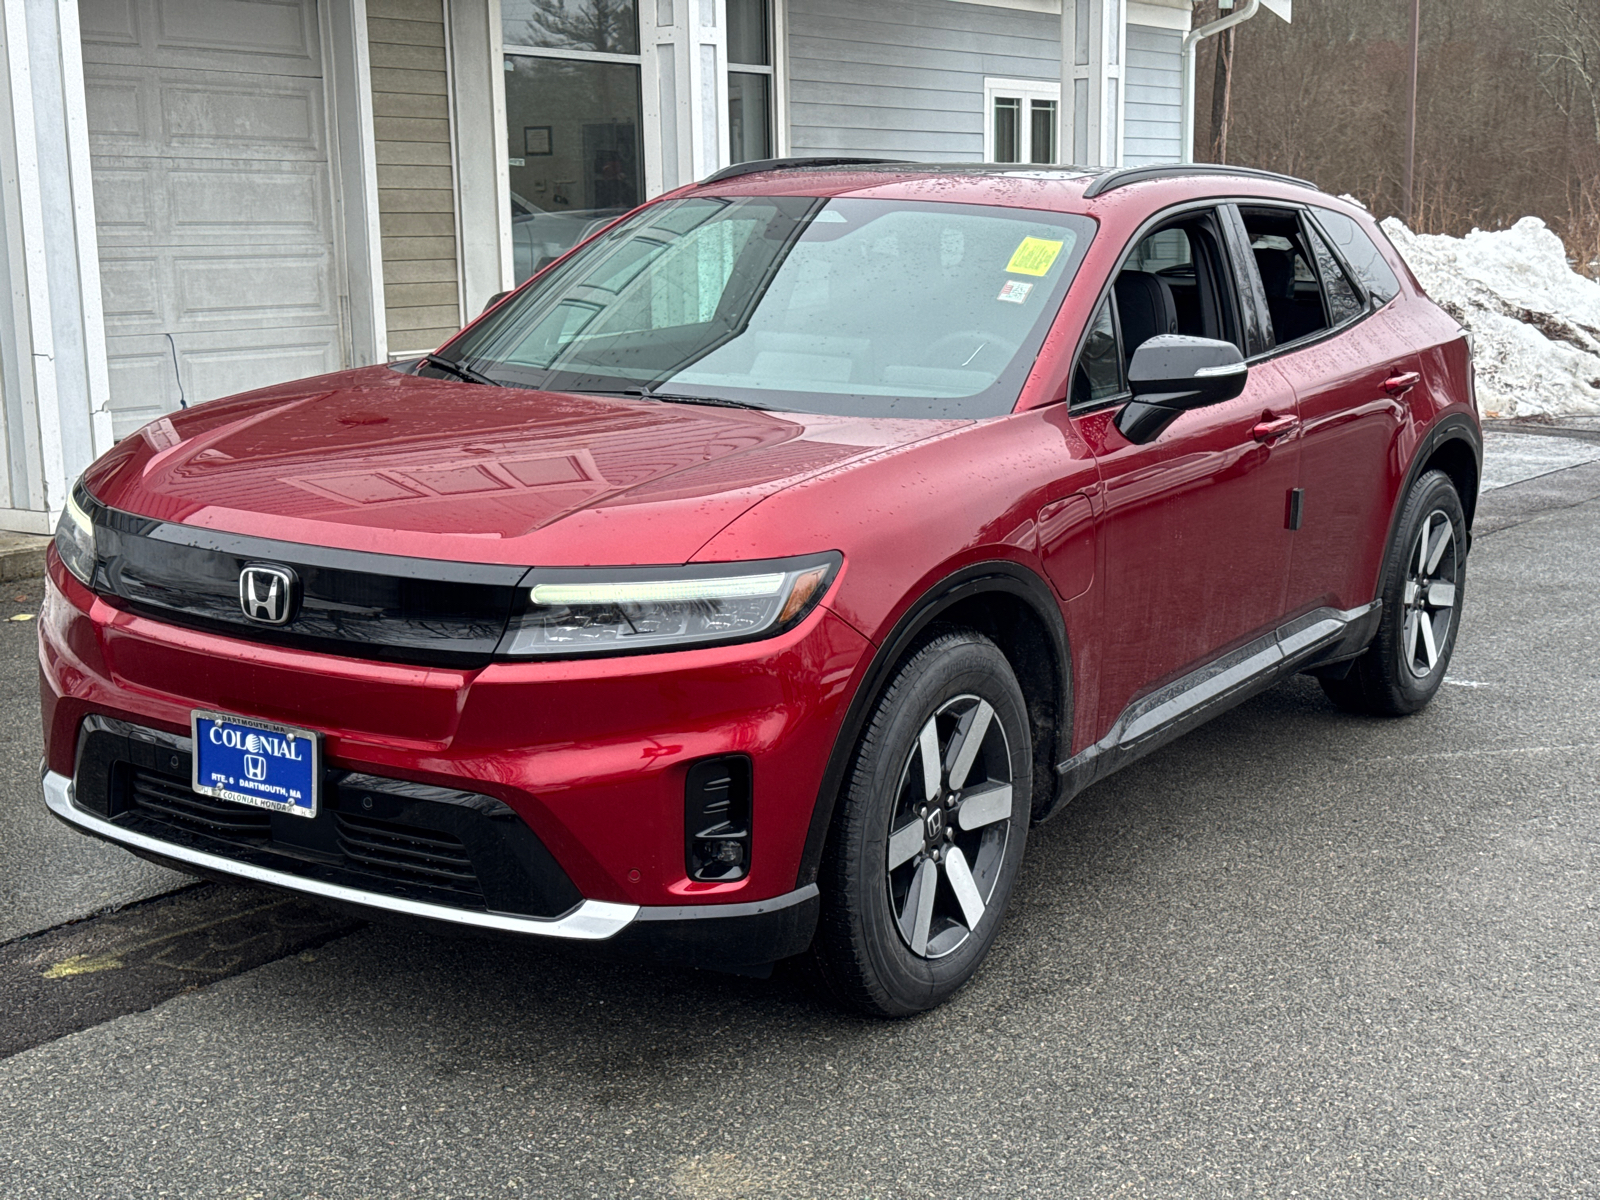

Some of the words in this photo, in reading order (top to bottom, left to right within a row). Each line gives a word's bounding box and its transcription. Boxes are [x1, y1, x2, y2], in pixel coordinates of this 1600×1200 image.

[209, 726, 302, 761] COLONIAL
[211, 773, 228, 783] RTE.
[239, 779, 288, 797] DARTMOUTH,
[290, 789, 301, 798] MA
[223, 792, 258, 805] COLONIAL
[260, 800, 286, 811] HONDA
